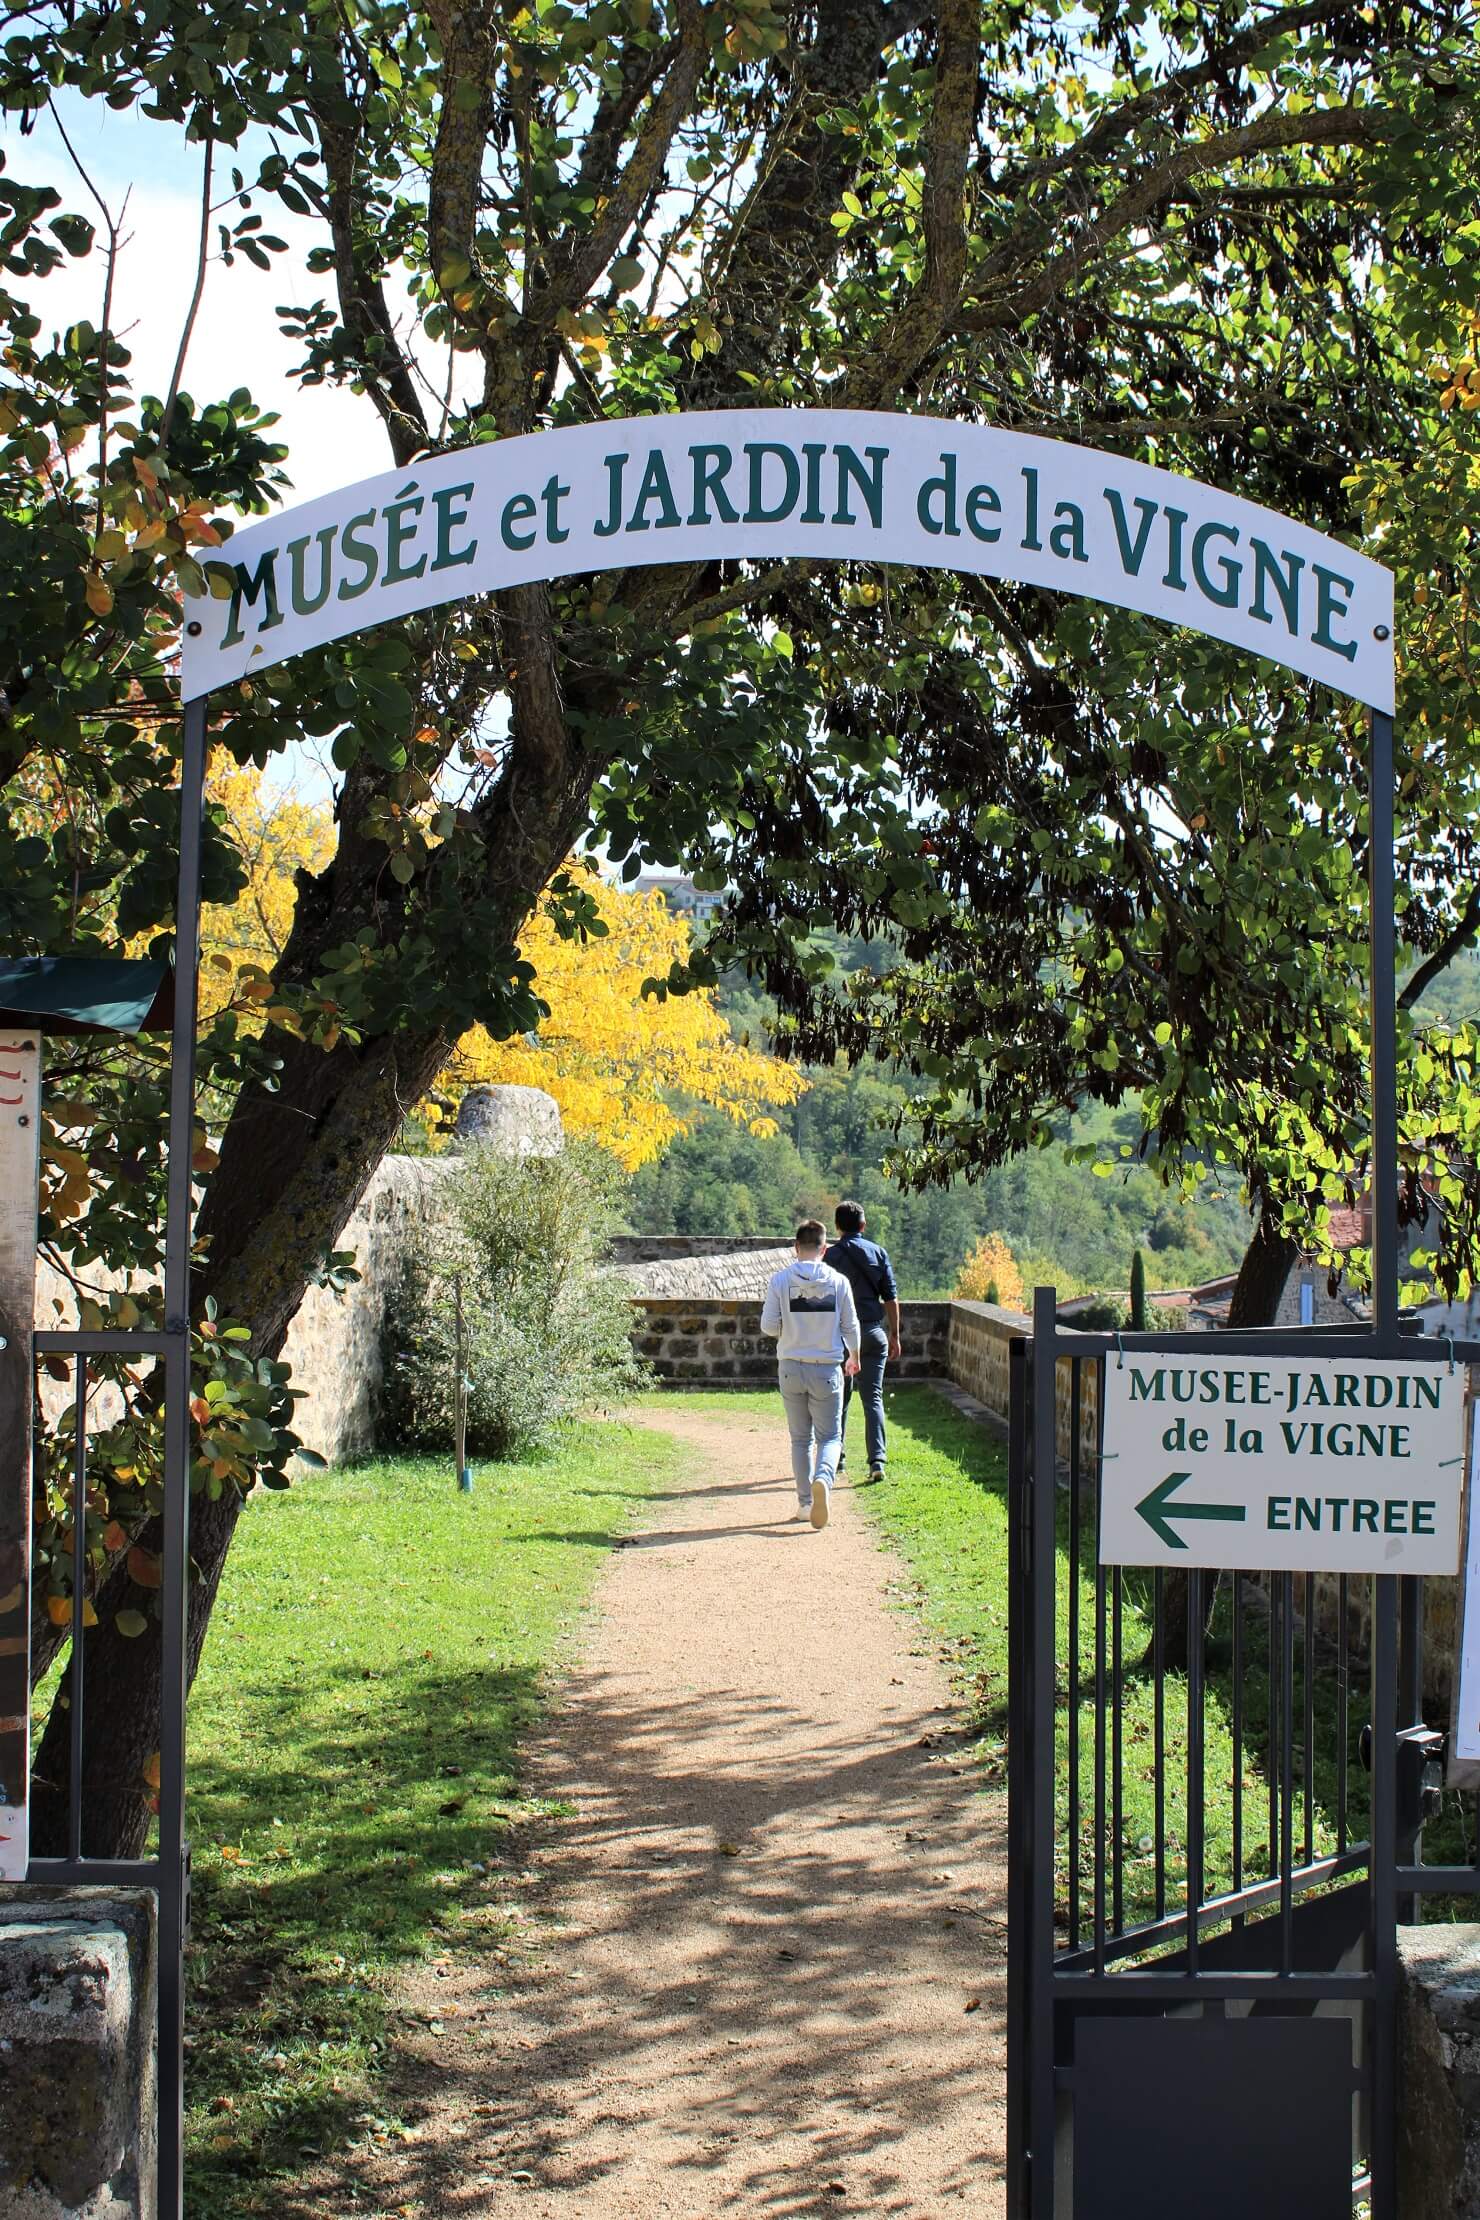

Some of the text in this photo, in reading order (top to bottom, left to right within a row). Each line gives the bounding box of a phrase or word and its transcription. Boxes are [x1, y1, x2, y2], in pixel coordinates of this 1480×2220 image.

[219, 442, 1358, 662] MUSÉE et JARDIN de la VIGNE
[1129, 1368, 1442, 1413] MUSEE-JARDIN
[1162, 1418, 1411, 1457] de la VIGNE
[1267, 1496, 1436, 1535] ENTREE
